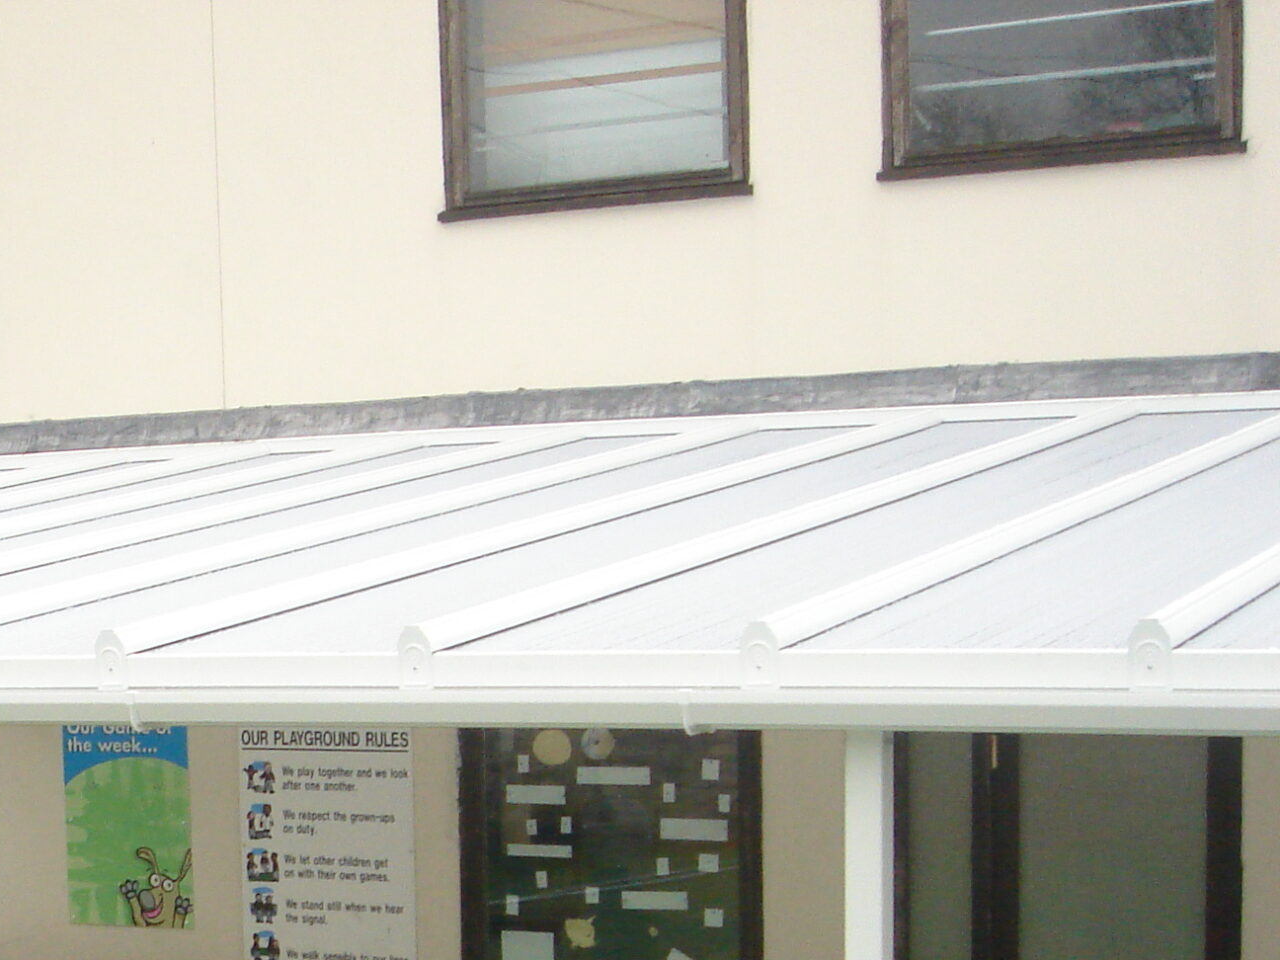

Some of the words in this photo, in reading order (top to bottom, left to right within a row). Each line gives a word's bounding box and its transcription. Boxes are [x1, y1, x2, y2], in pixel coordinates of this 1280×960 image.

[67, 737, 92, 752] the
[241, 730, 269, 746] OUR
[274, 731, 360, 747] PLAYGROUND
[365, 732, 409, 748] RULES
[282, 766, 294, 777] We
[297, 767, 314, 779] play
[318, 767, 353, 779] together
[356, 768, 372, 778] and
[375, 770, 387, 779] we
[390, 768, 408, 779] look
[282, 781, 301, 791] after
[304, 783, 320, 791] one
[323, 781, 357, 792] another.
[282, 809, 296, 820] We
[298, 810, 330, 823] respect
[333, 811, 347, 822] the
[350, 813, 395, 825] grown-ups
[283, 825, 294, 833] on
[296, 823, 317, 836] duty.
[284, 854, 296, 865] We
[299, 855, 310, 866] let
[313, 856, 335, 866] other
[338, 856, 371, 867] children
[374, 858, 388, 870] get
[284, 869, 295, 878] on
[298, 869, 314, 879] with
[317, 869, 336, 880] their
[339, 872, 357, 881] own
[359, 872, 390, 884] games.
[286, 899, 297, 909] We
[301, 900, 324, 911] stand
[327, 901, 342, 911] still
[345, 902, 366, 912] when
[370, 904, 382, 914] we
[385, 903, 404, 914] hear
[285, 914, 298, 923] the
[286, 949, 298, 959] We
[302, 950, 319, 960] walk
